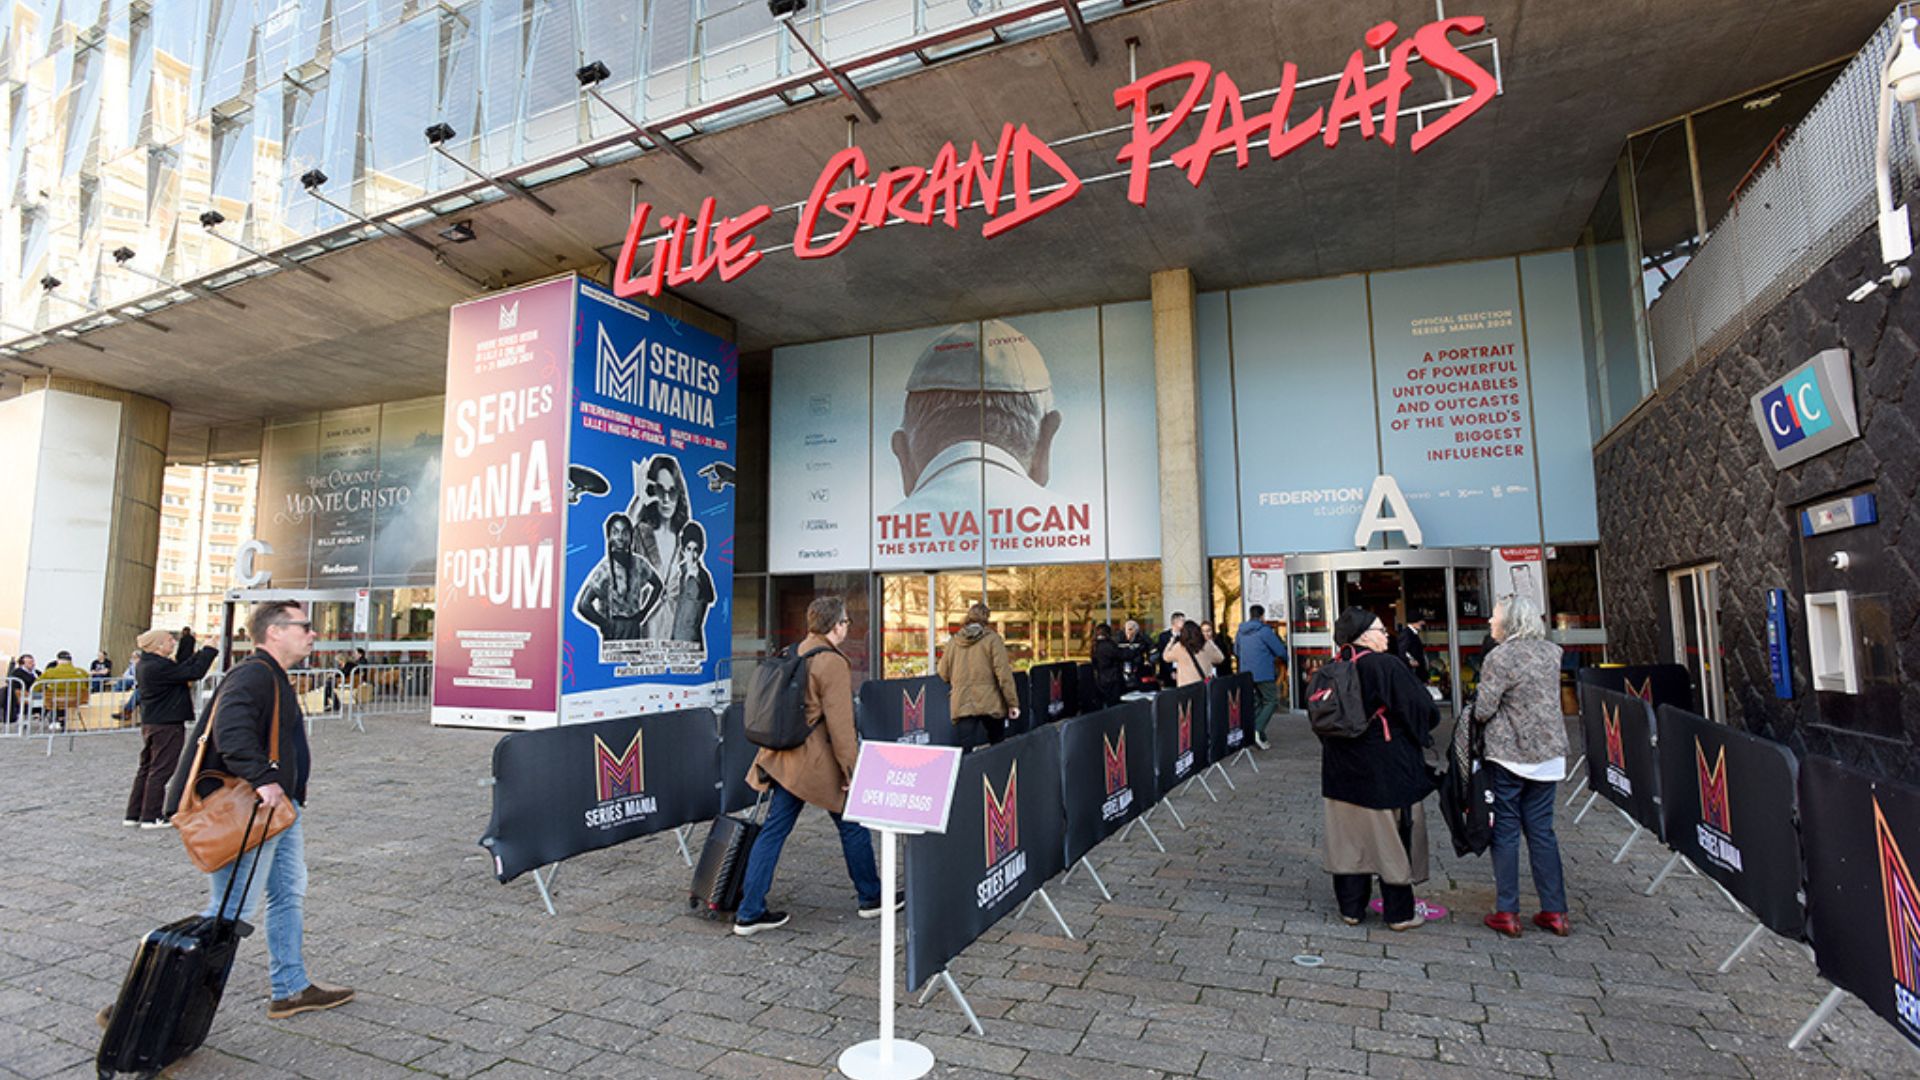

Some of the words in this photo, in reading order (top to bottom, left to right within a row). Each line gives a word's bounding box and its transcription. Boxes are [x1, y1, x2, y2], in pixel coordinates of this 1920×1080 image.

[793, 121, 1083, 260] GRAND
[1411, 316, 1454, 327] OFFICIAL
[1458, 310, 1512, 322] SELECTION
[1412, 326, 1446, 336] SERIES
[1449, 321, 1484, 333] MANIA
[1423, 351, 1433, 362] A
[1438, 344, 1515, 361] PORTRAIT
[650, 342, 720, 395] SERIES
[1407, 368, 1427, 381] OF
[1432, 360, 1518, 379] POWERFUL
[1392, 376, 1518, 399] UNTOUCHABLES
[649, 378, 715, 428] MANIA
[1396, 401, 1430, 414] AND
[1434, 393, 1520, 411] OUTCASTS
[1770, 382, 1822, 436] CIC
[454, 384, 553, 459] SERIES
[1391, 419, 1410, 431] OF
[1416, 416, 1445, 429] THE
[1449, 408, 1521, 426] WORLD'S
[1455, 427, 1522, 443] BIGGEST
[1427, 444, 1524, 461] INFLUENCER
[446, 440, 553, 523] MANIA
[1355, 474, 1423, 549] A
[877, 512, 932, 540] THE
[878, 543, 905, 555] THE
[909, 540, 954, 554] STATE
[959, 539, 980, 552] OF
[991, 537, 1018, 550] THE
[1023, 534, 1091, 548] CHURCH
[235, 540, 272, 588] C
[443, 544, 554, 610] FORUM
[886, 768, 919, 788] PLEASE
[584, 802, 624, 828] SERIES
[625, 796, 658, 818] MANIA
[862, 788, 884, 806] OPEN
[884, 791, 908, 809] YOUR
[907, 794, 933, 812] BAGS
[977, 868, 1004, 908] SERIES
[1004, 850, 1027, 888] MANIA
